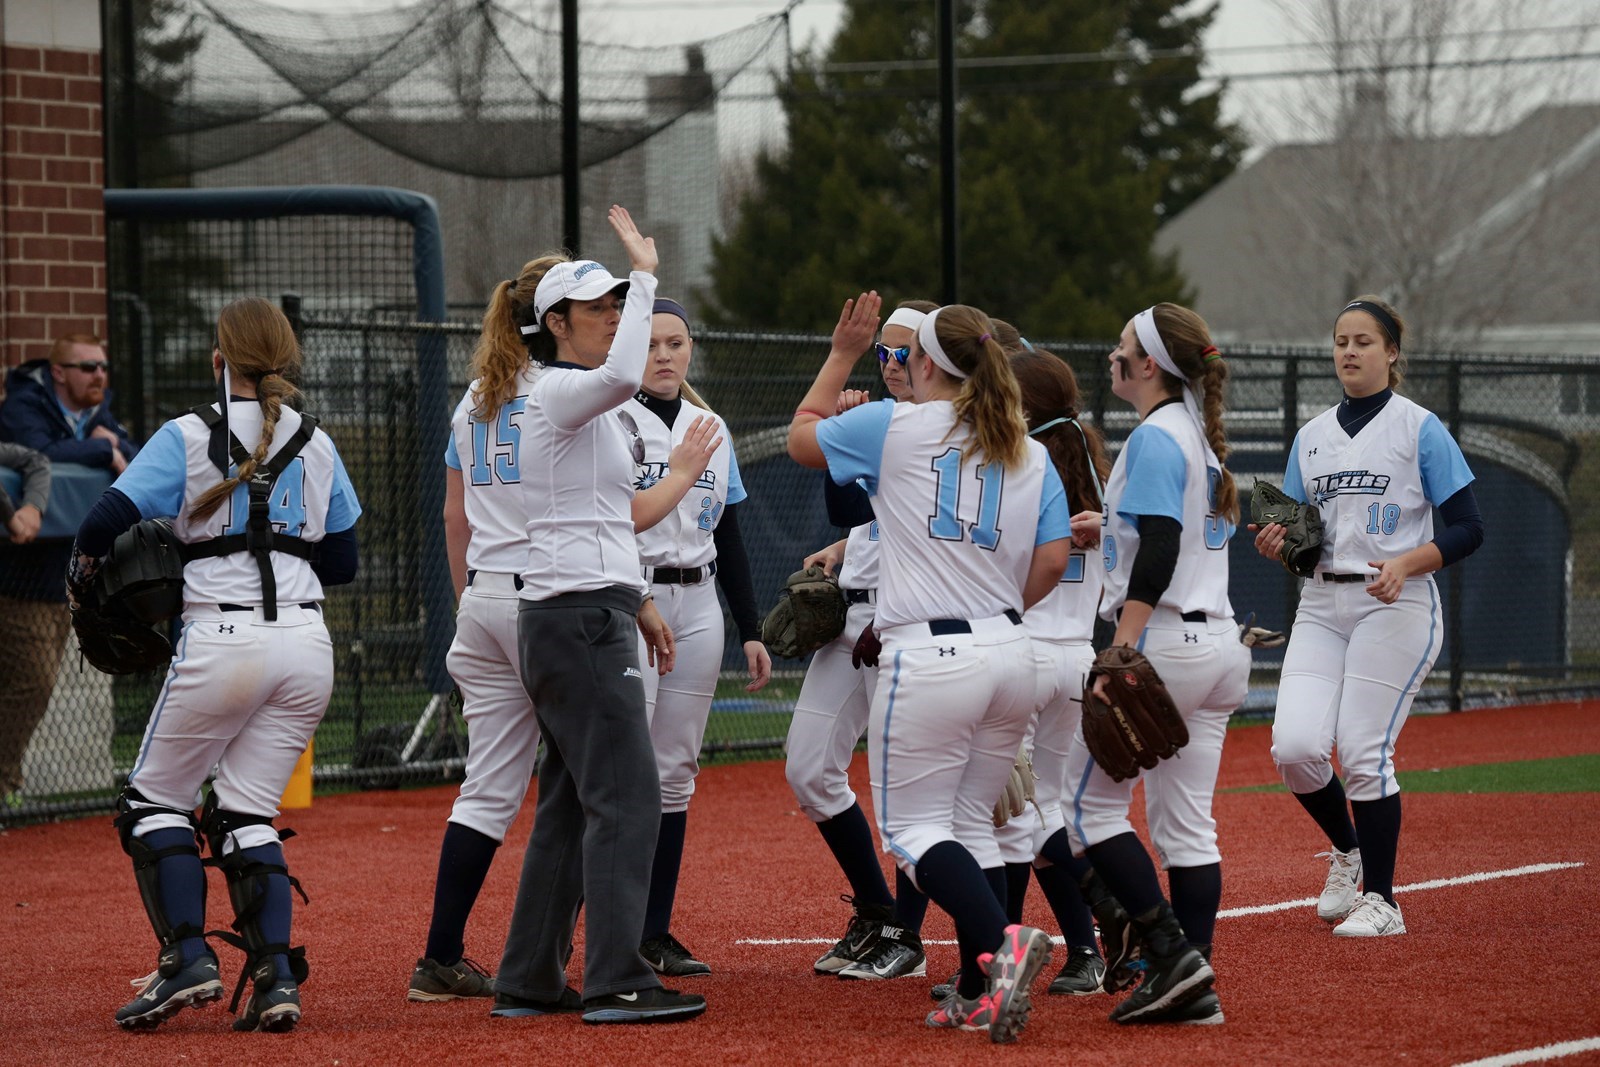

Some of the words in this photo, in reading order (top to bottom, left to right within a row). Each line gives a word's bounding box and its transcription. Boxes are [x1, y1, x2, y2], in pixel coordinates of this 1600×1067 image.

[468, 394, 529, 486] 15
[928, 446, 1005, 552] 11
[1366, 502, 1401, 535] 18
[881, 925, 904, 940] NIKE
